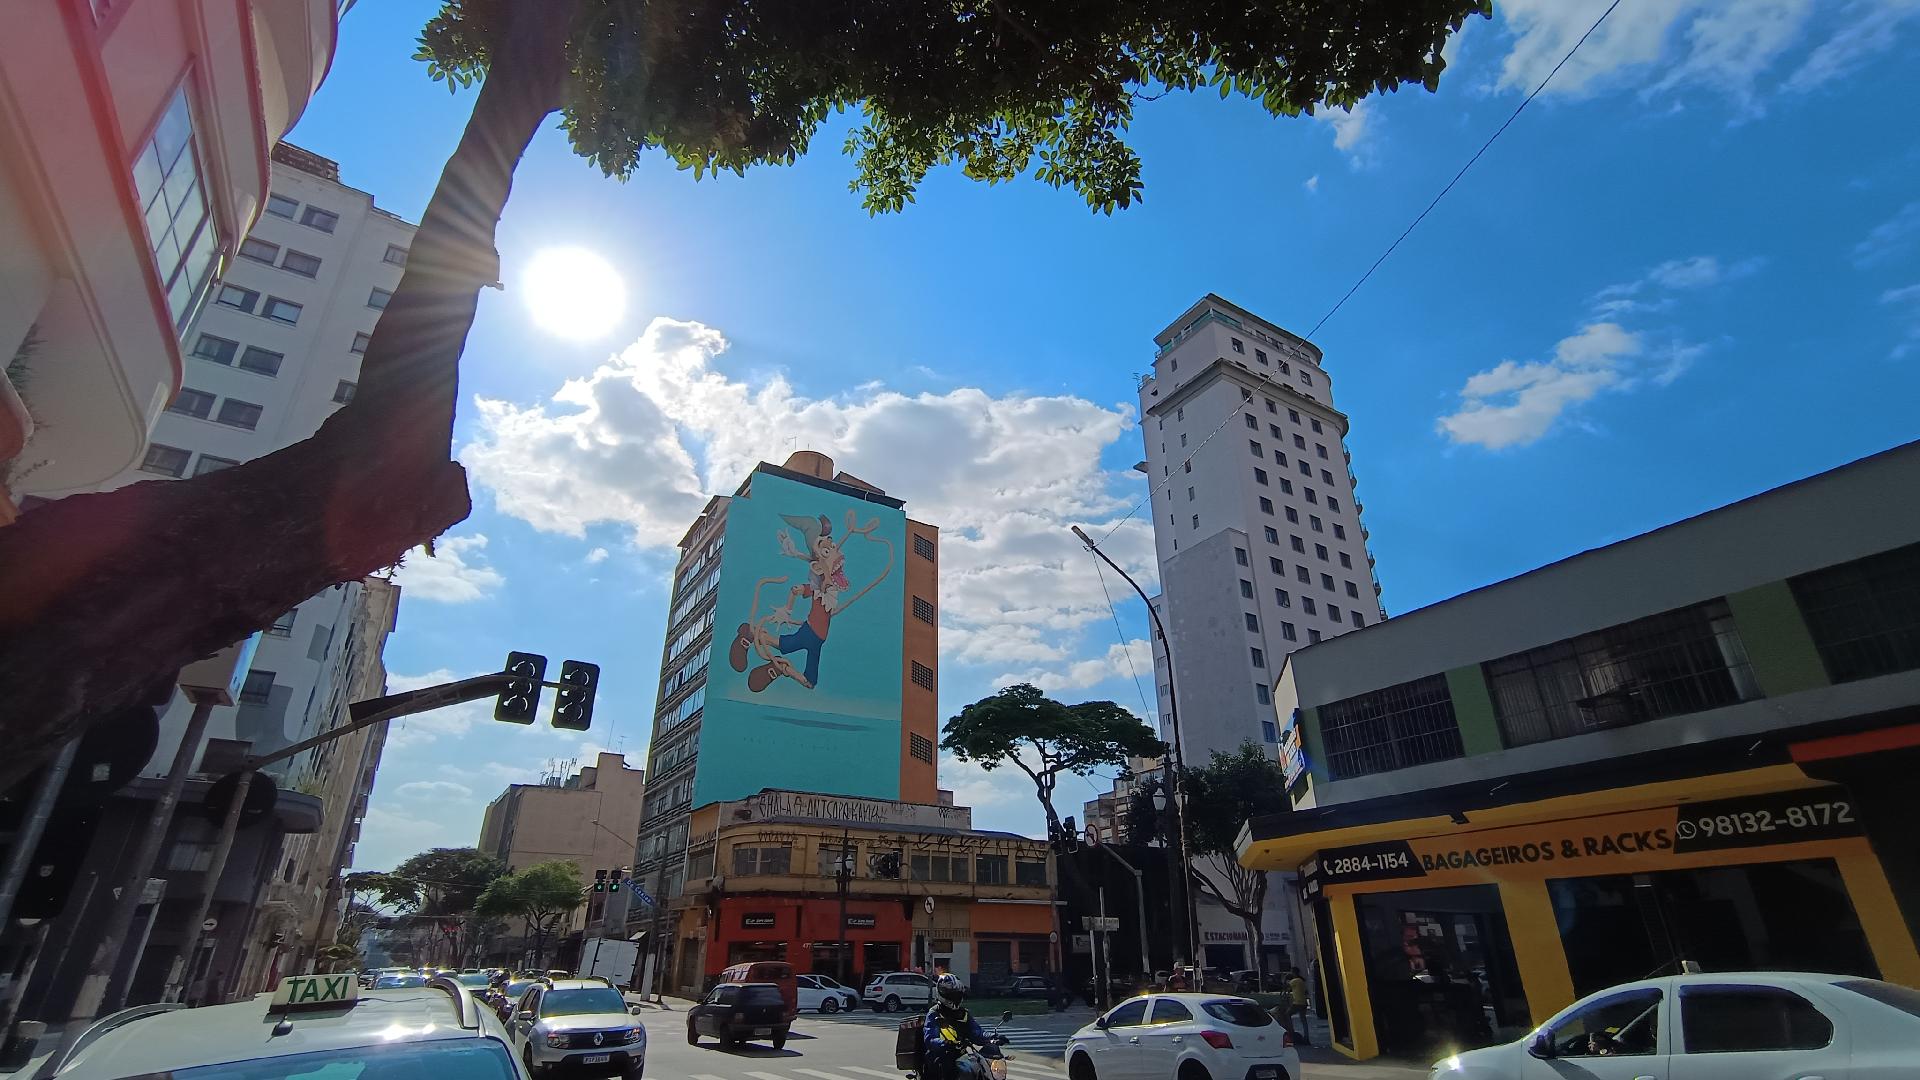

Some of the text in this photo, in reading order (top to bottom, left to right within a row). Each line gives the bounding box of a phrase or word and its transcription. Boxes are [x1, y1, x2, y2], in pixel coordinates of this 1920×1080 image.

[1698, 801, 1856, 837] 98132-8172
[1334, 851, 1409, 874] 2884-1154
[1421, 828, 1673, 871] BAGAGEIROS & RACKS
[287, 976, 350, 1003] TAXI
